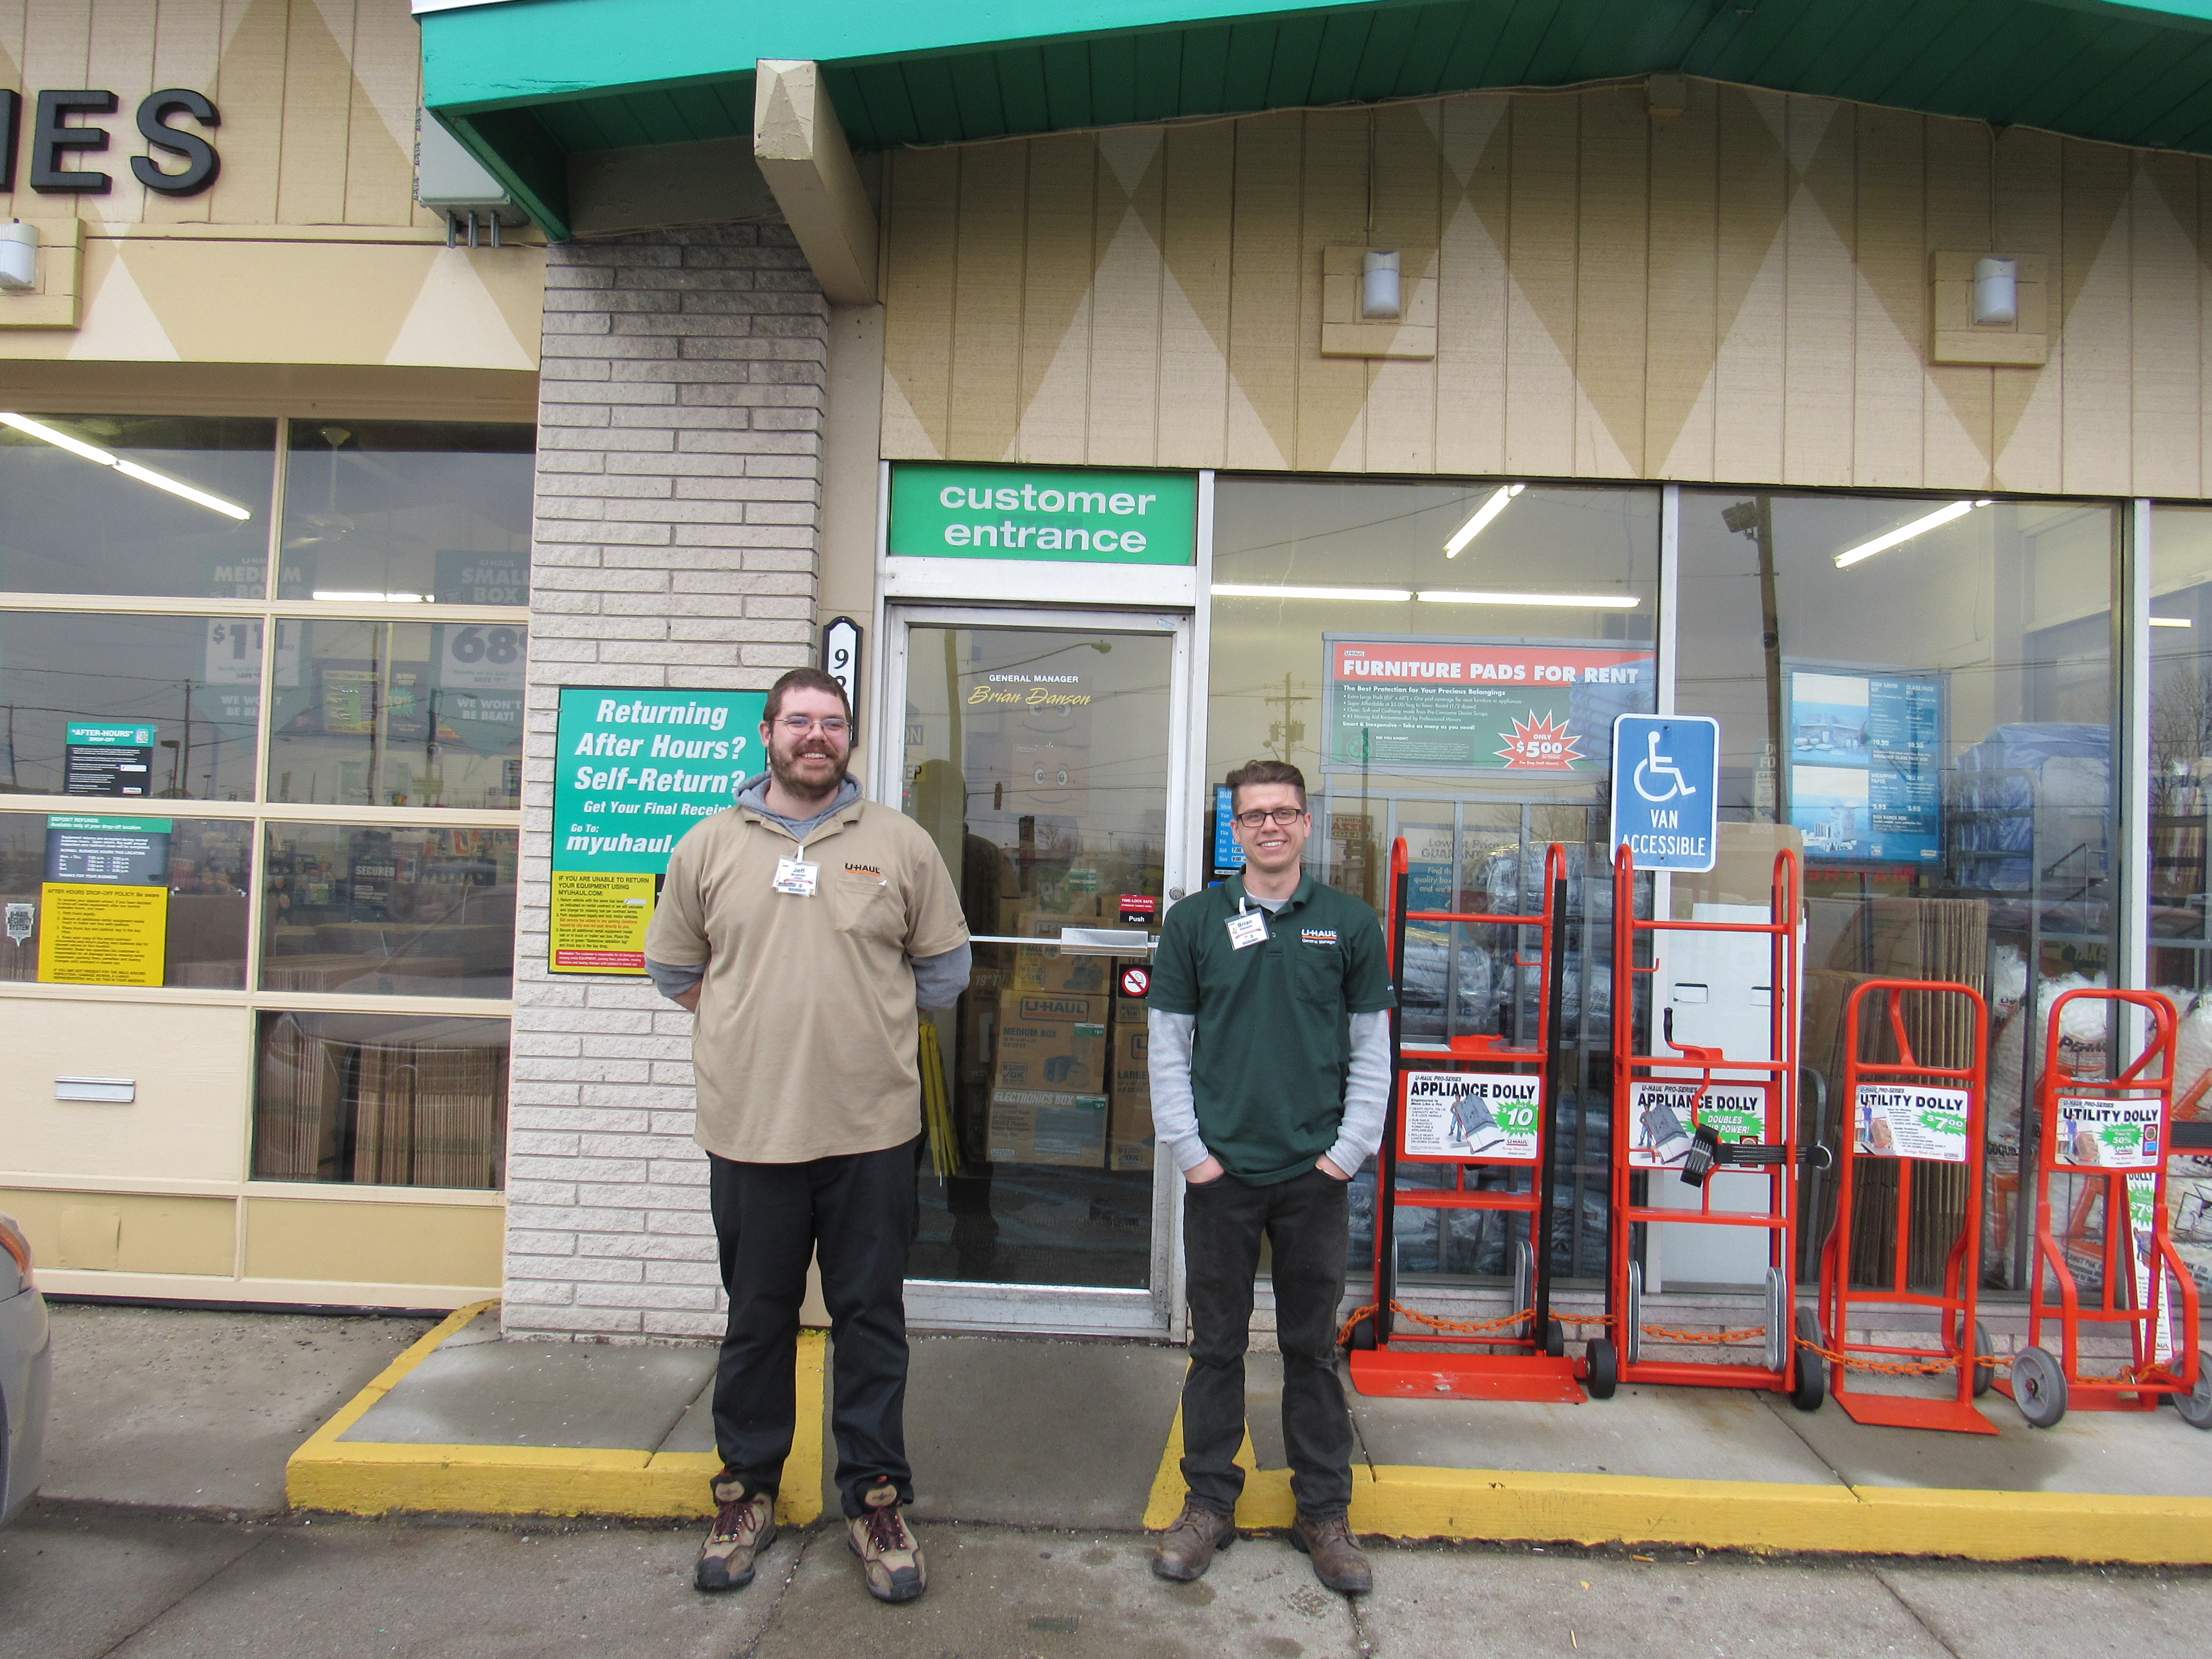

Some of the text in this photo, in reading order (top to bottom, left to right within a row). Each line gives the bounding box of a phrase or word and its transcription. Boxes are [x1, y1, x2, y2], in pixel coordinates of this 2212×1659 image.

[940, 484, 1156, 515] customer
[944, 521, 1147, 553] entrance
[473, 587, 518, 603] BOX
[1034, 675, 1079, 683] MANAGER
[1344, 660, 1638, 684] FURNITURE PADS FOR RENT
[967, 685, 1091, 705] Brian Danson
[457, 699, 522, 710] WE WON'T
[463, 710, 514, 721] BE BEAT!
[596, 699, 729, 731] Returning
[575, 733, 746, 759] After Hours?
[575, 766, 746, 793] Self-Return?
[584, 800, 677, 815] Get Your Final
[1650, 809, 1678, 829] VAN
[571, 823, 600, 833] Go To:
[1623, 834, 1706, 855] ACCESSIBLE
[845, 863, 880, 874] U-HAUL
[1238, 919, 1252, 928] Brian
[1301, 928, 1337, 937] U-HAUL
[1025, 1000, 1084, 1014] U-HAUL
[1003, 1027, 1056, 1038] MEDIUM BOX
[1118, 1070, 1147, 1080] LARGE
[994, 1091, 1074, 1105] ELECTRONICS BOX
[1411, 1082, 1536, 1099] APPLIANCE DOLLY
[1717, 1096, 1758, 1111] DOLLY
[1860, 1094, 1963, 1110] UTILITY DOLLY
[1502, 1107, 1534, 1126] $10
[1707, 1115, 1743, 1124] DOUBLES
[2063, 1108, 2158, 1122] UTILITY DOLLY
[1720, 1125, 1750, 1134] POWER!
